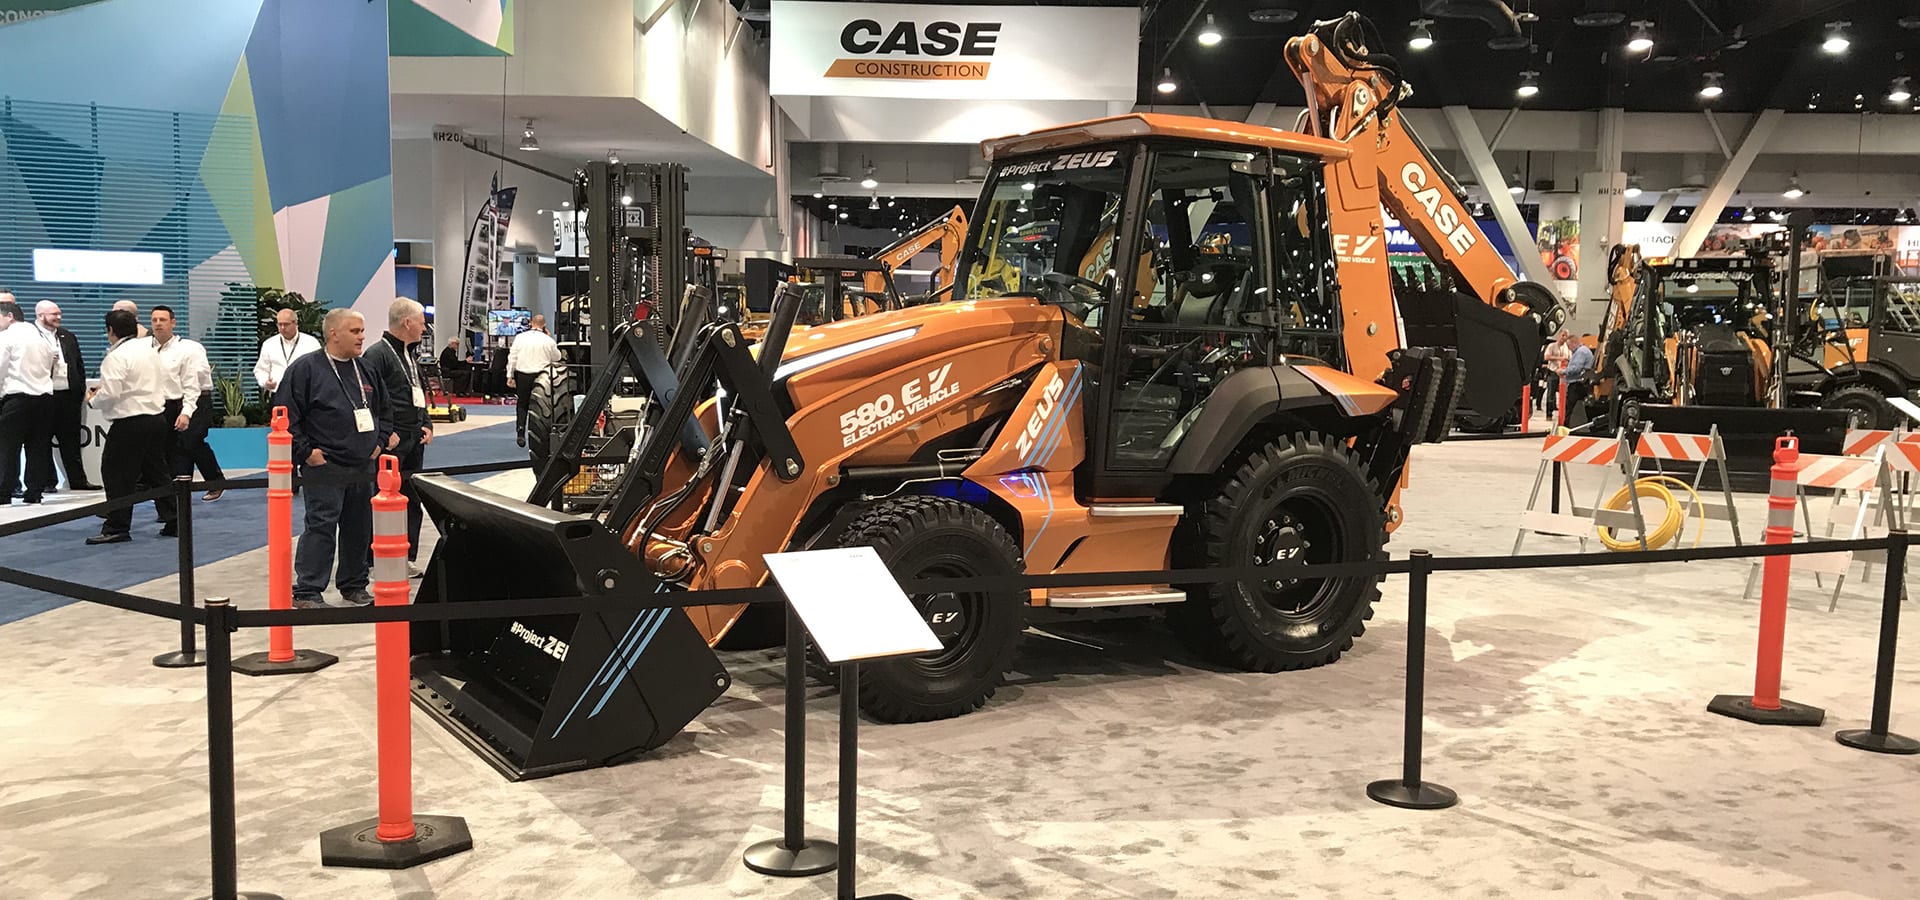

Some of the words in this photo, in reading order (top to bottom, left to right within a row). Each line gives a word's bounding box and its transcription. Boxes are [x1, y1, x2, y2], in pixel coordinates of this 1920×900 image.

[840, 19, 1002, 57] CASE
[855, 61, 985, 78] CONSTRUCTION
[1000, 161, 1051, 177] #Project
[1052, 150, 1119, 171] ZEUS
[1401, 161, 1477, 257] CASE
[563, 220, 587, 234] HYDR
[896, 241, 921, 261] CASE
[840, 395, 895, 435] 580
[843, 407, 905, 448] ELECTRIC
[907, 382, 960, 415] VEHICLE
[1016, 373, 1065, 462] ZEUS
[1276, 547, 1300, 560] EV
[932, 612, 959, 624] EV
[510, 620, 545, 649] #Project
